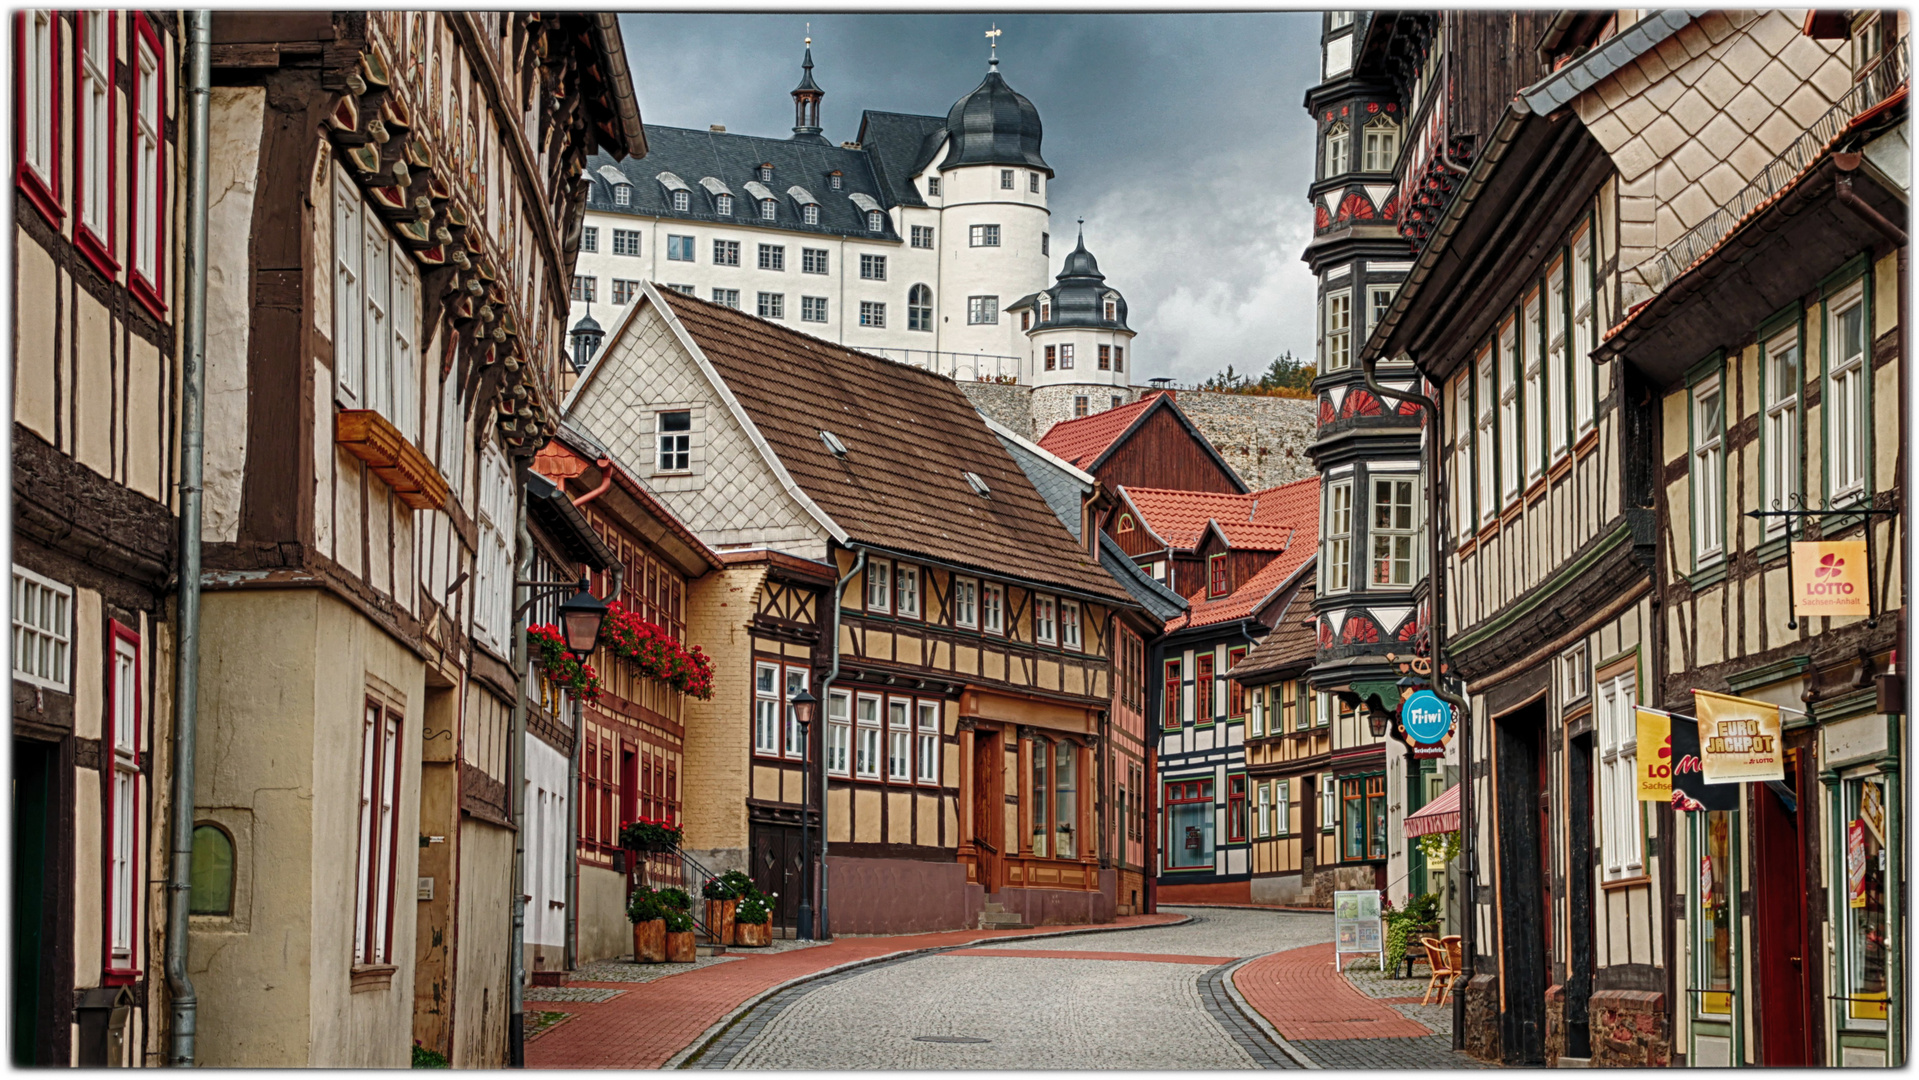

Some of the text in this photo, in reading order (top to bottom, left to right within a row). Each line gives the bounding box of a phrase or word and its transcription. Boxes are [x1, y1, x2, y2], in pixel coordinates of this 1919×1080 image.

[1807, 582, 1854, 595] LOTTO
[1802, 597, 1861, 606] Sachsen-Anhalt
[1411, 708, 1441, 724] Friwi
[1717, 719, 1759, 737] EURO
[1706, 735, 1774, 754] JACKPOT
